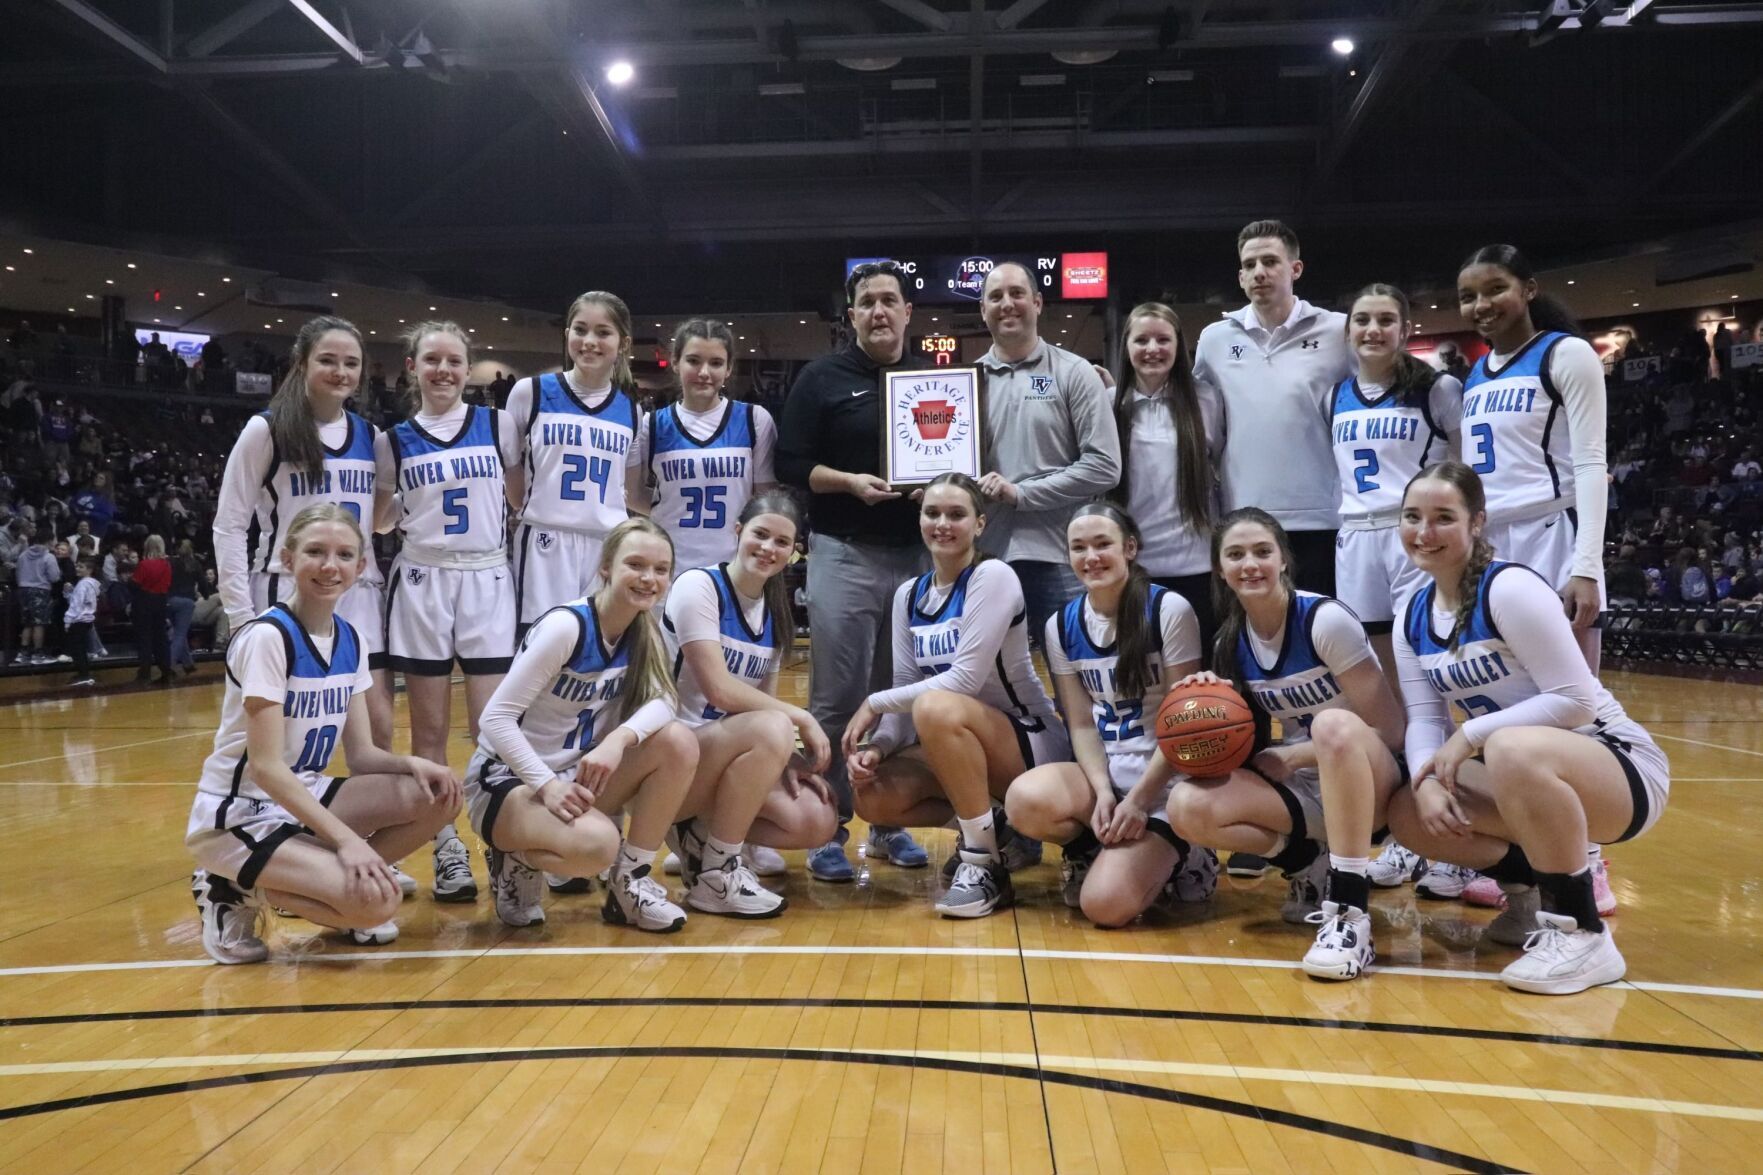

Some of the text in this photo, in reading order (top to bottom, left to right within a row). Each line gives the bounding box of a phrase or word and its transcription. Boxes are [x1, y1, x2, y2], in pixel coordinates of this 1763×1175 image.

[961, 261, 994, 273] 15:00
[1037, 258, 1057, 270] RV
[915, 277, 924, 289] 0
[947, 279, 955, 289] 0
[957, 280, 978, 289] Team
[1043, 274, 1052, 286] 0
[921, 338, 956, 352] 15:00
[898, 380, 967, 410] HERITAGE
[1031, 376, 1053, 394] RV
[1484, 388, 1537, 414] VALLEY
[912, 410, 957, 425] Athletics
[1365, 416, 1419, 441] VALLEY
[542, 423, 583, 446] RIVER
[896, 419, 970, 456] CONFERENCE
[1471, 422, 1496, 475] 3
[403, 461, 446, 492] RIVER
[560, 453, 612, 505] 24
[661, 456, 746, 482] RIVER VALLEY
[1353, 448, 1381, 494] 2
[442, 487, 469, 535] 5
[679, 486, 728, 529] 35
[1447, 651, 1511, 690] VALLEY
[1281, 671, 1342, 709] VALLEY
[1097, 699, 1144, 741] 22
[1164, 705, 1227, 731] SPALDING
[290, 724, 338, 774] 10
[1171, 734, 1228, 754] LEGACY
